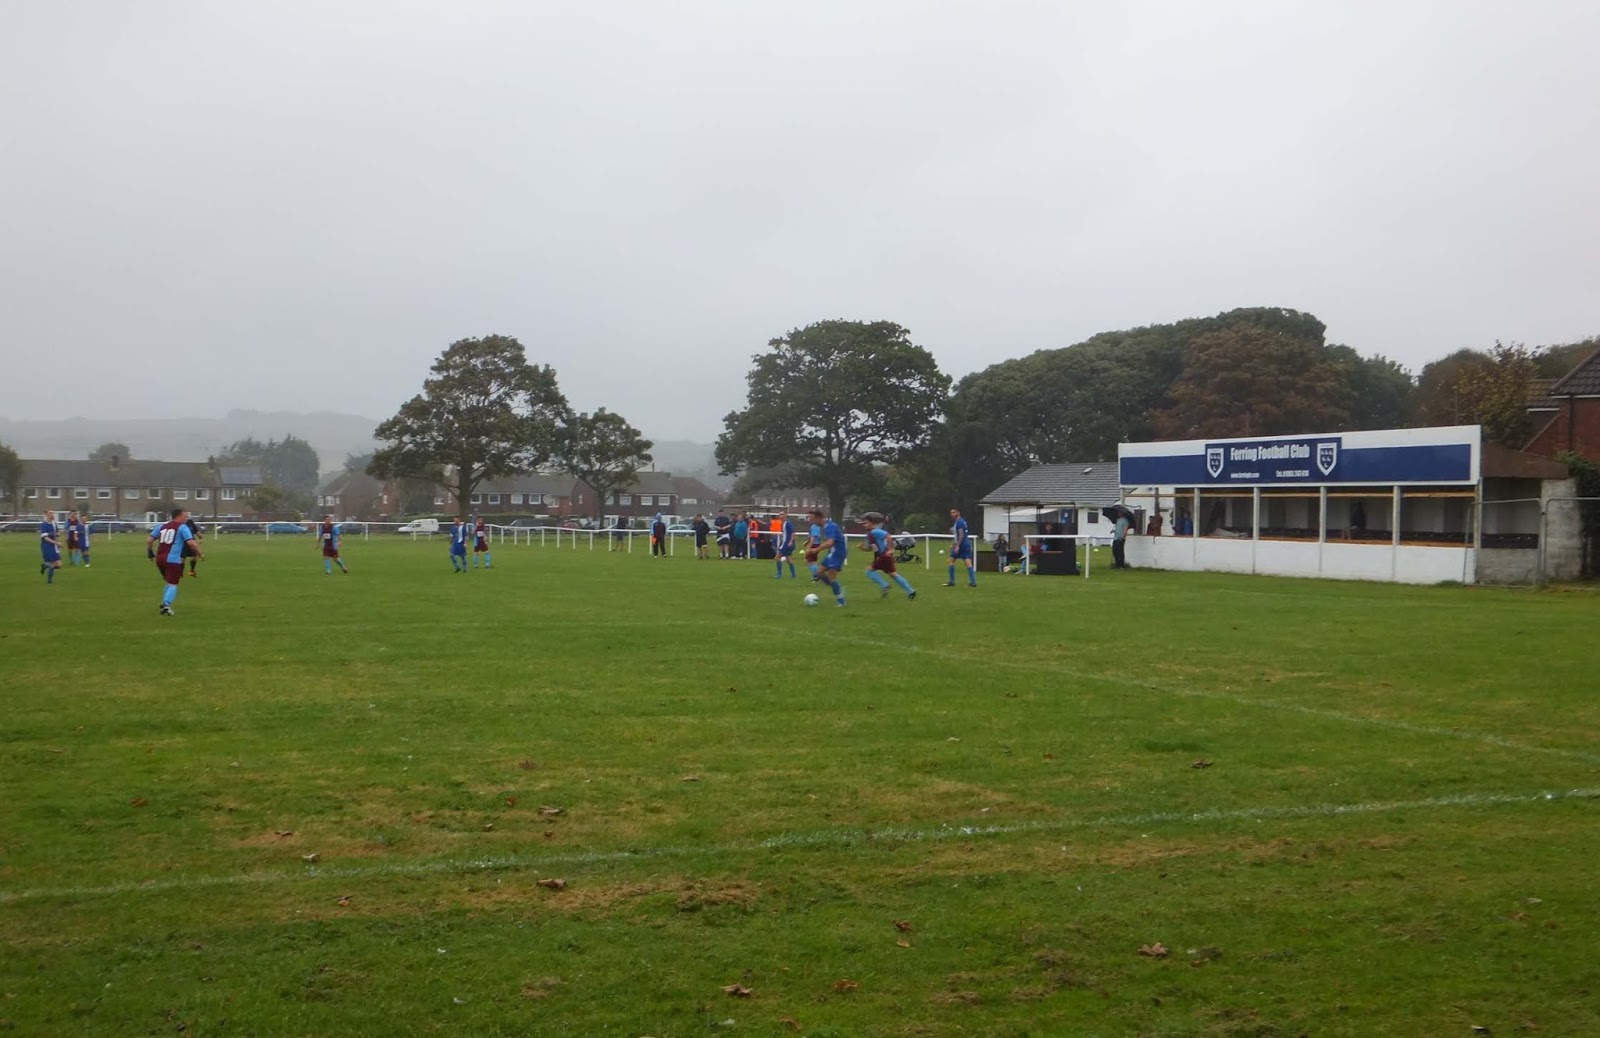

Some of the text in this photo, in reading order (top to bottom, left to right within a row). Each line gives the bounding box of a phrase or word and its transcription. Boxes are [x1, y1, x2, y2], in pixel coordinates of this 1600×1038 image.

[1230, 444, 1310, 462] Ferring Football Club
[160, 528, 176, 544] 10
